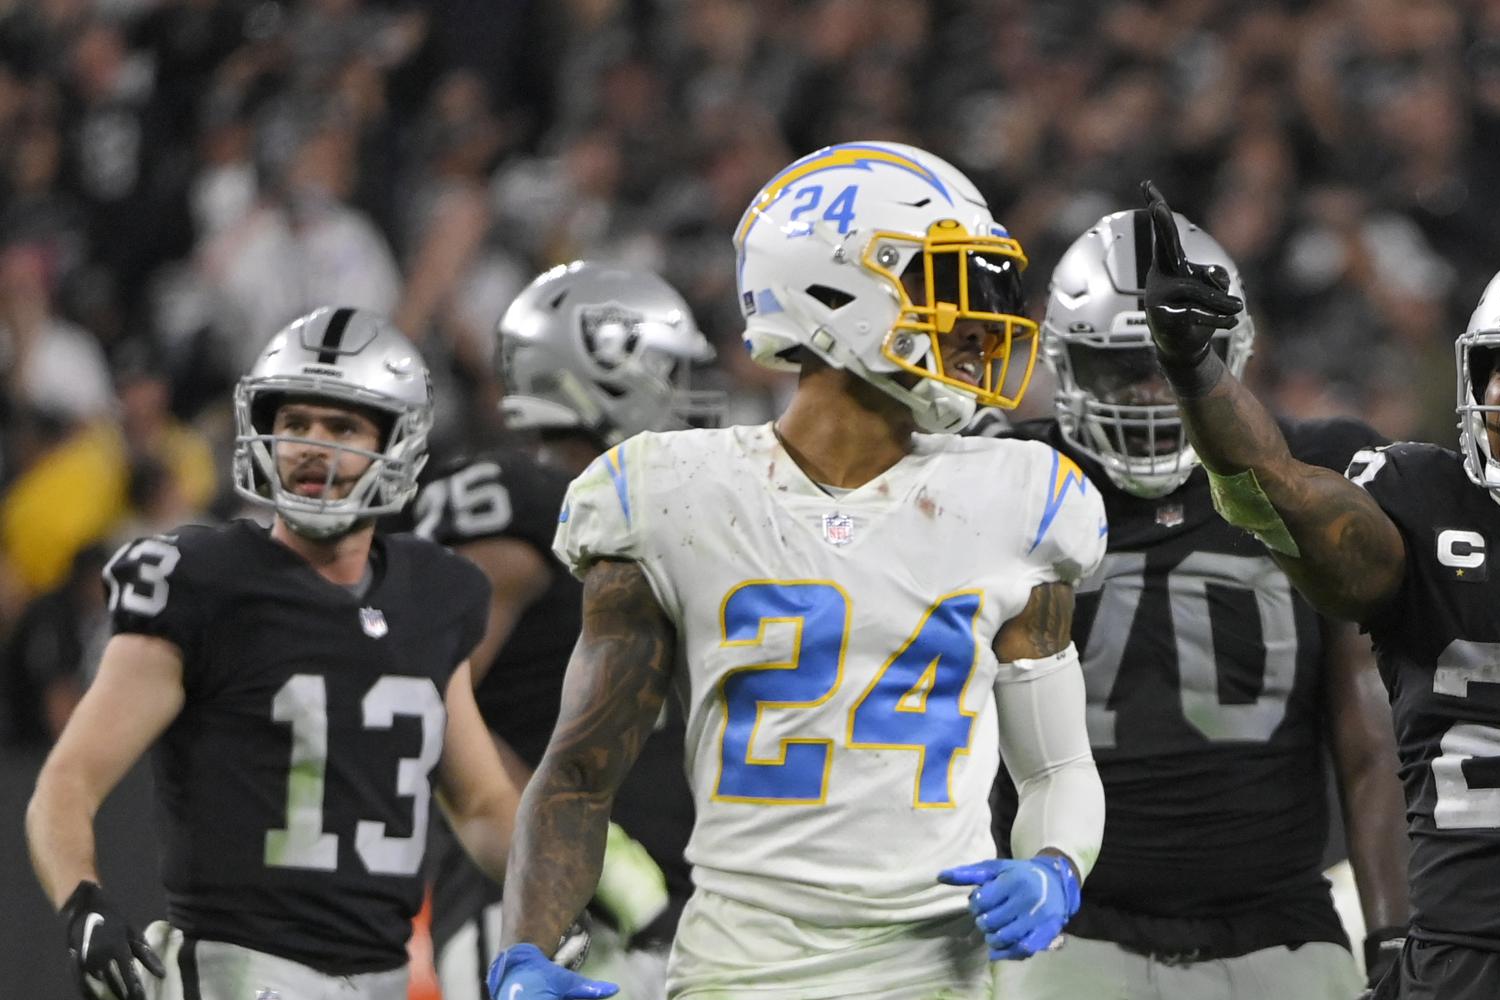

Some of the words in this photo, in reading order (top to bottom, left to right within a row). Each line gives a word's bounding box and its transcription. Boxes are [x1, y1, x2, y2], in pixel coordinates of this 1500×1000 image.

[787, 185, 858, 237] 24
[412, 461, 513, 541] 75
[102, 539, 181, 617] 13
[1437, 529, 1486, 569] C
[1075, 551, 1297, 748] 70
[711, 578, 984, 810] 24
[264, 673, 447, 875] 13
